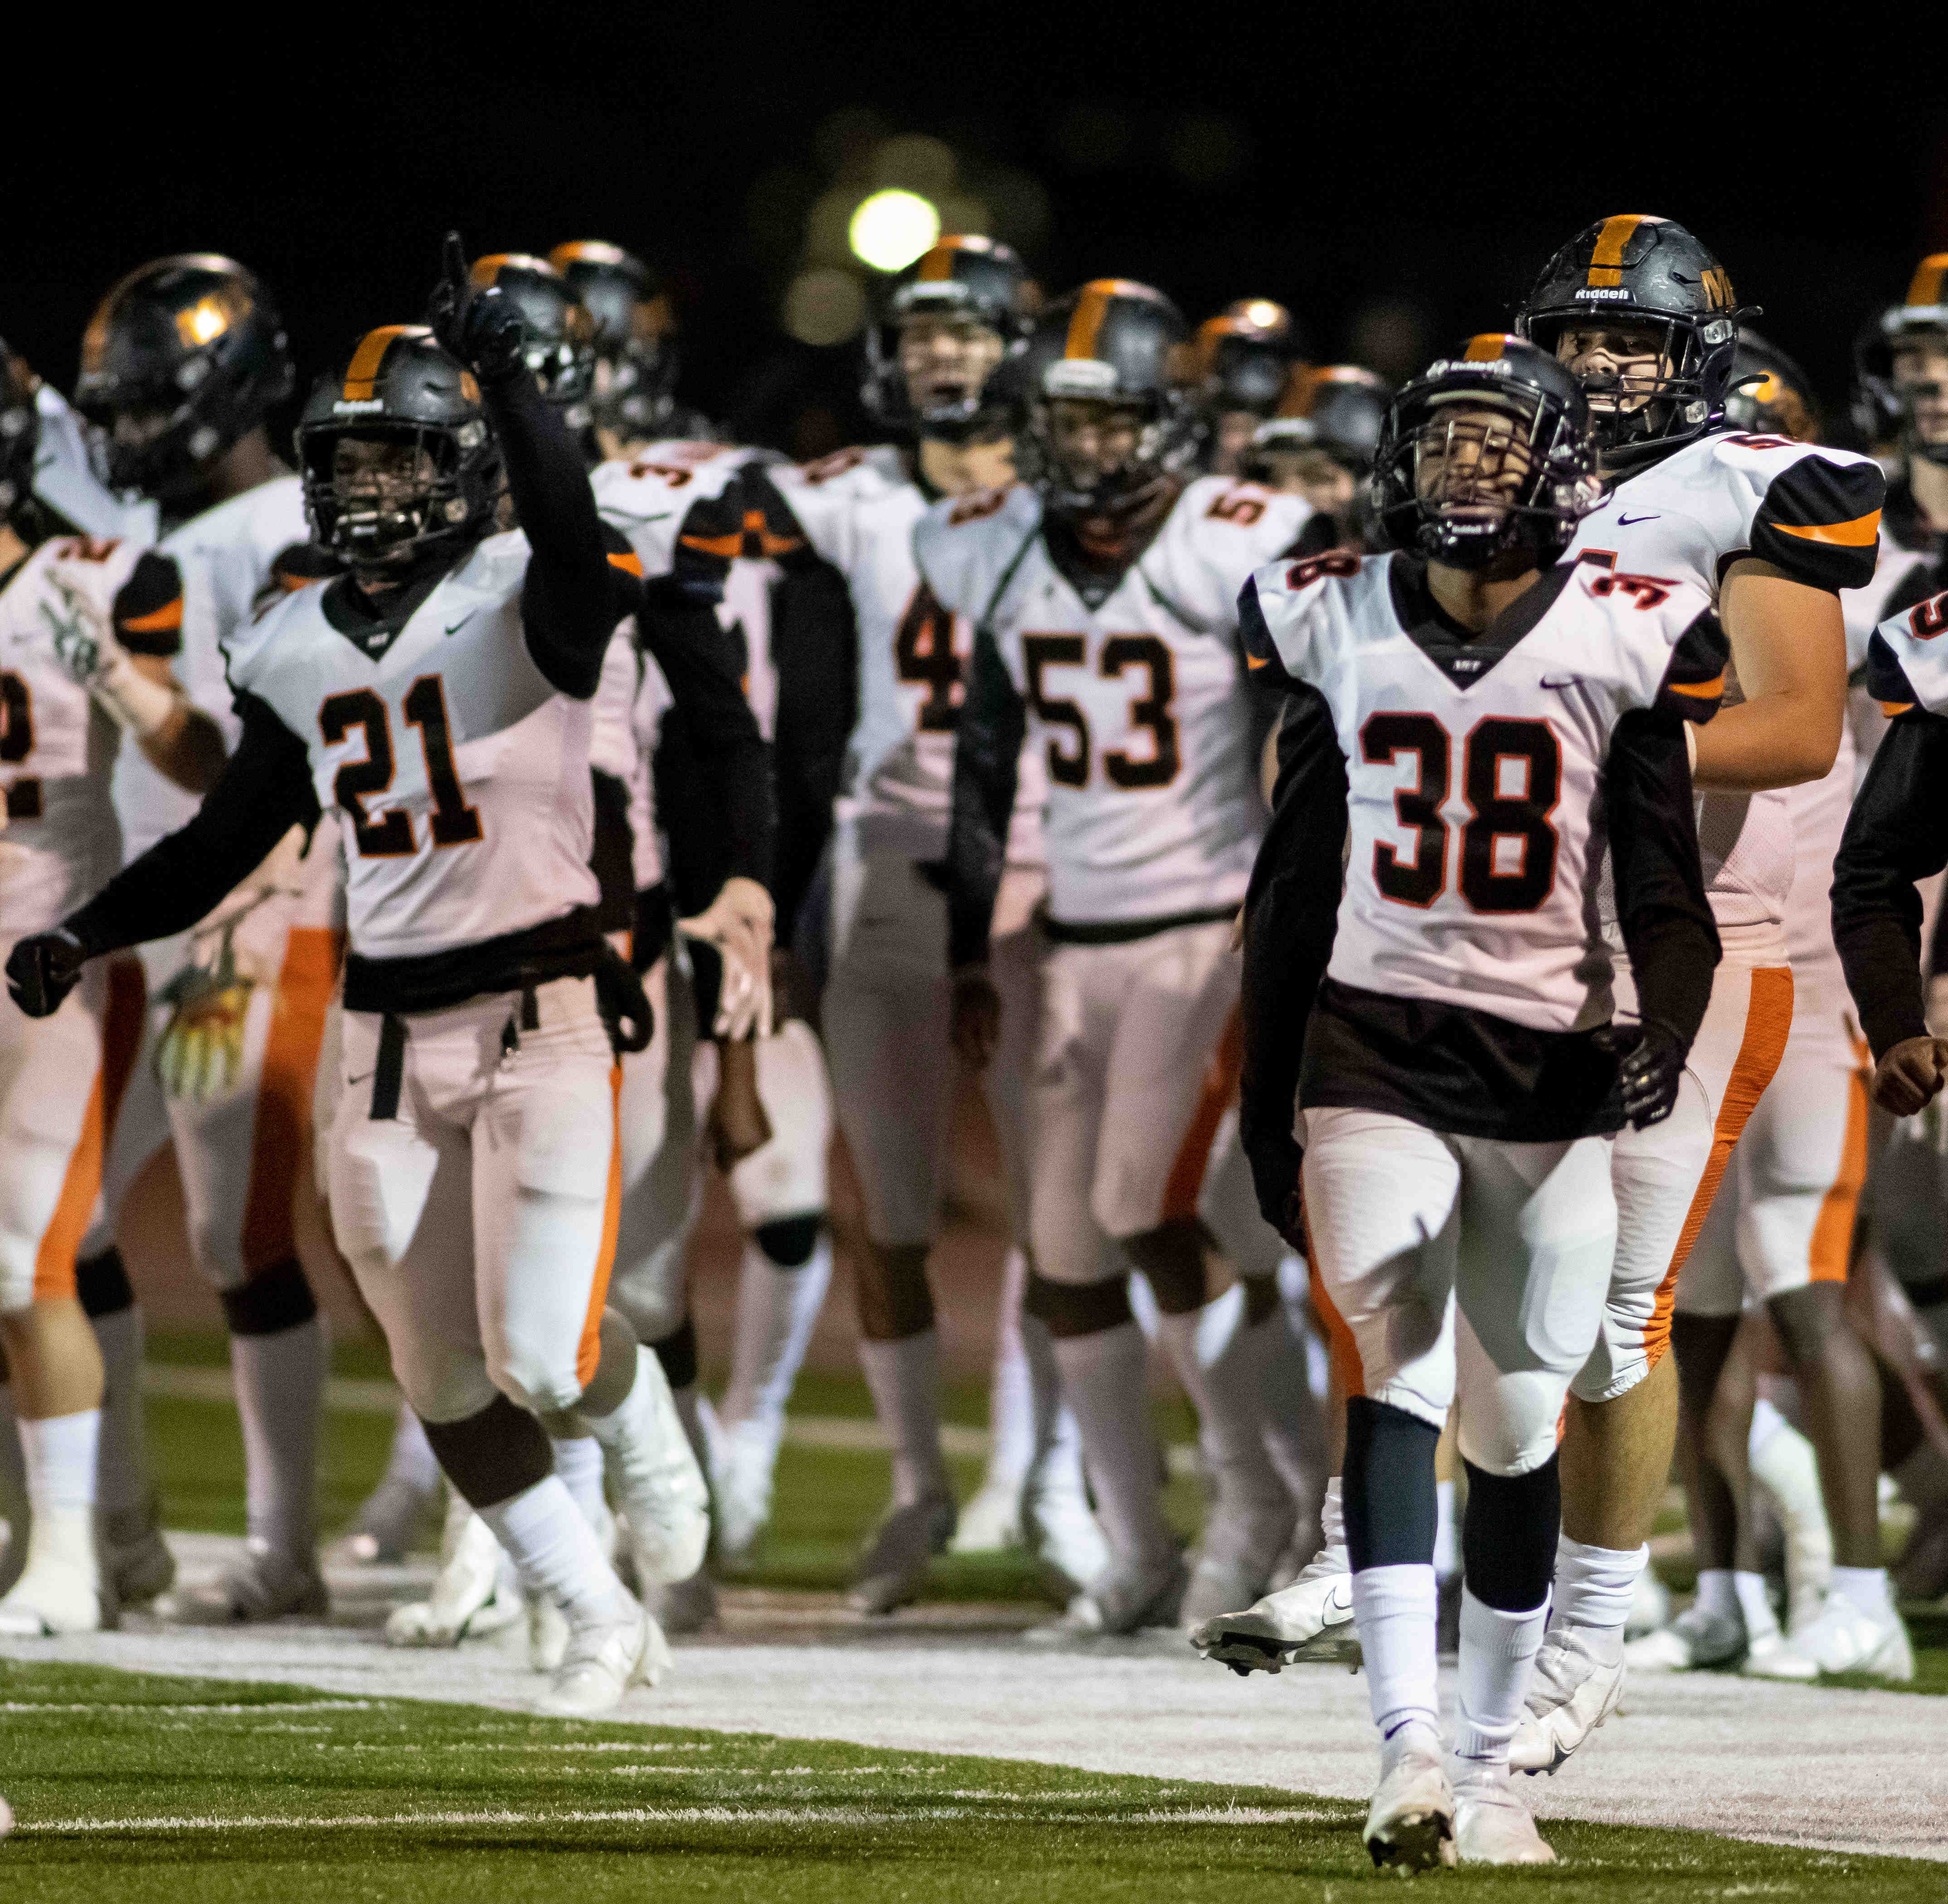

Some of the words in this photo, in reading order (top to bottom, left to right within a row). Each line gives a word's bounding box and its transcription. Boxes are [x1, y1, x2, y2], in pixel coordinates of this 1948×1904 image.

[1575, 288, 1629, 300] Riddell
[317, 672, 485, 858] 21
[1020, 629, 1182, 792] 53
[1358, 711, 1563, 915] 38
